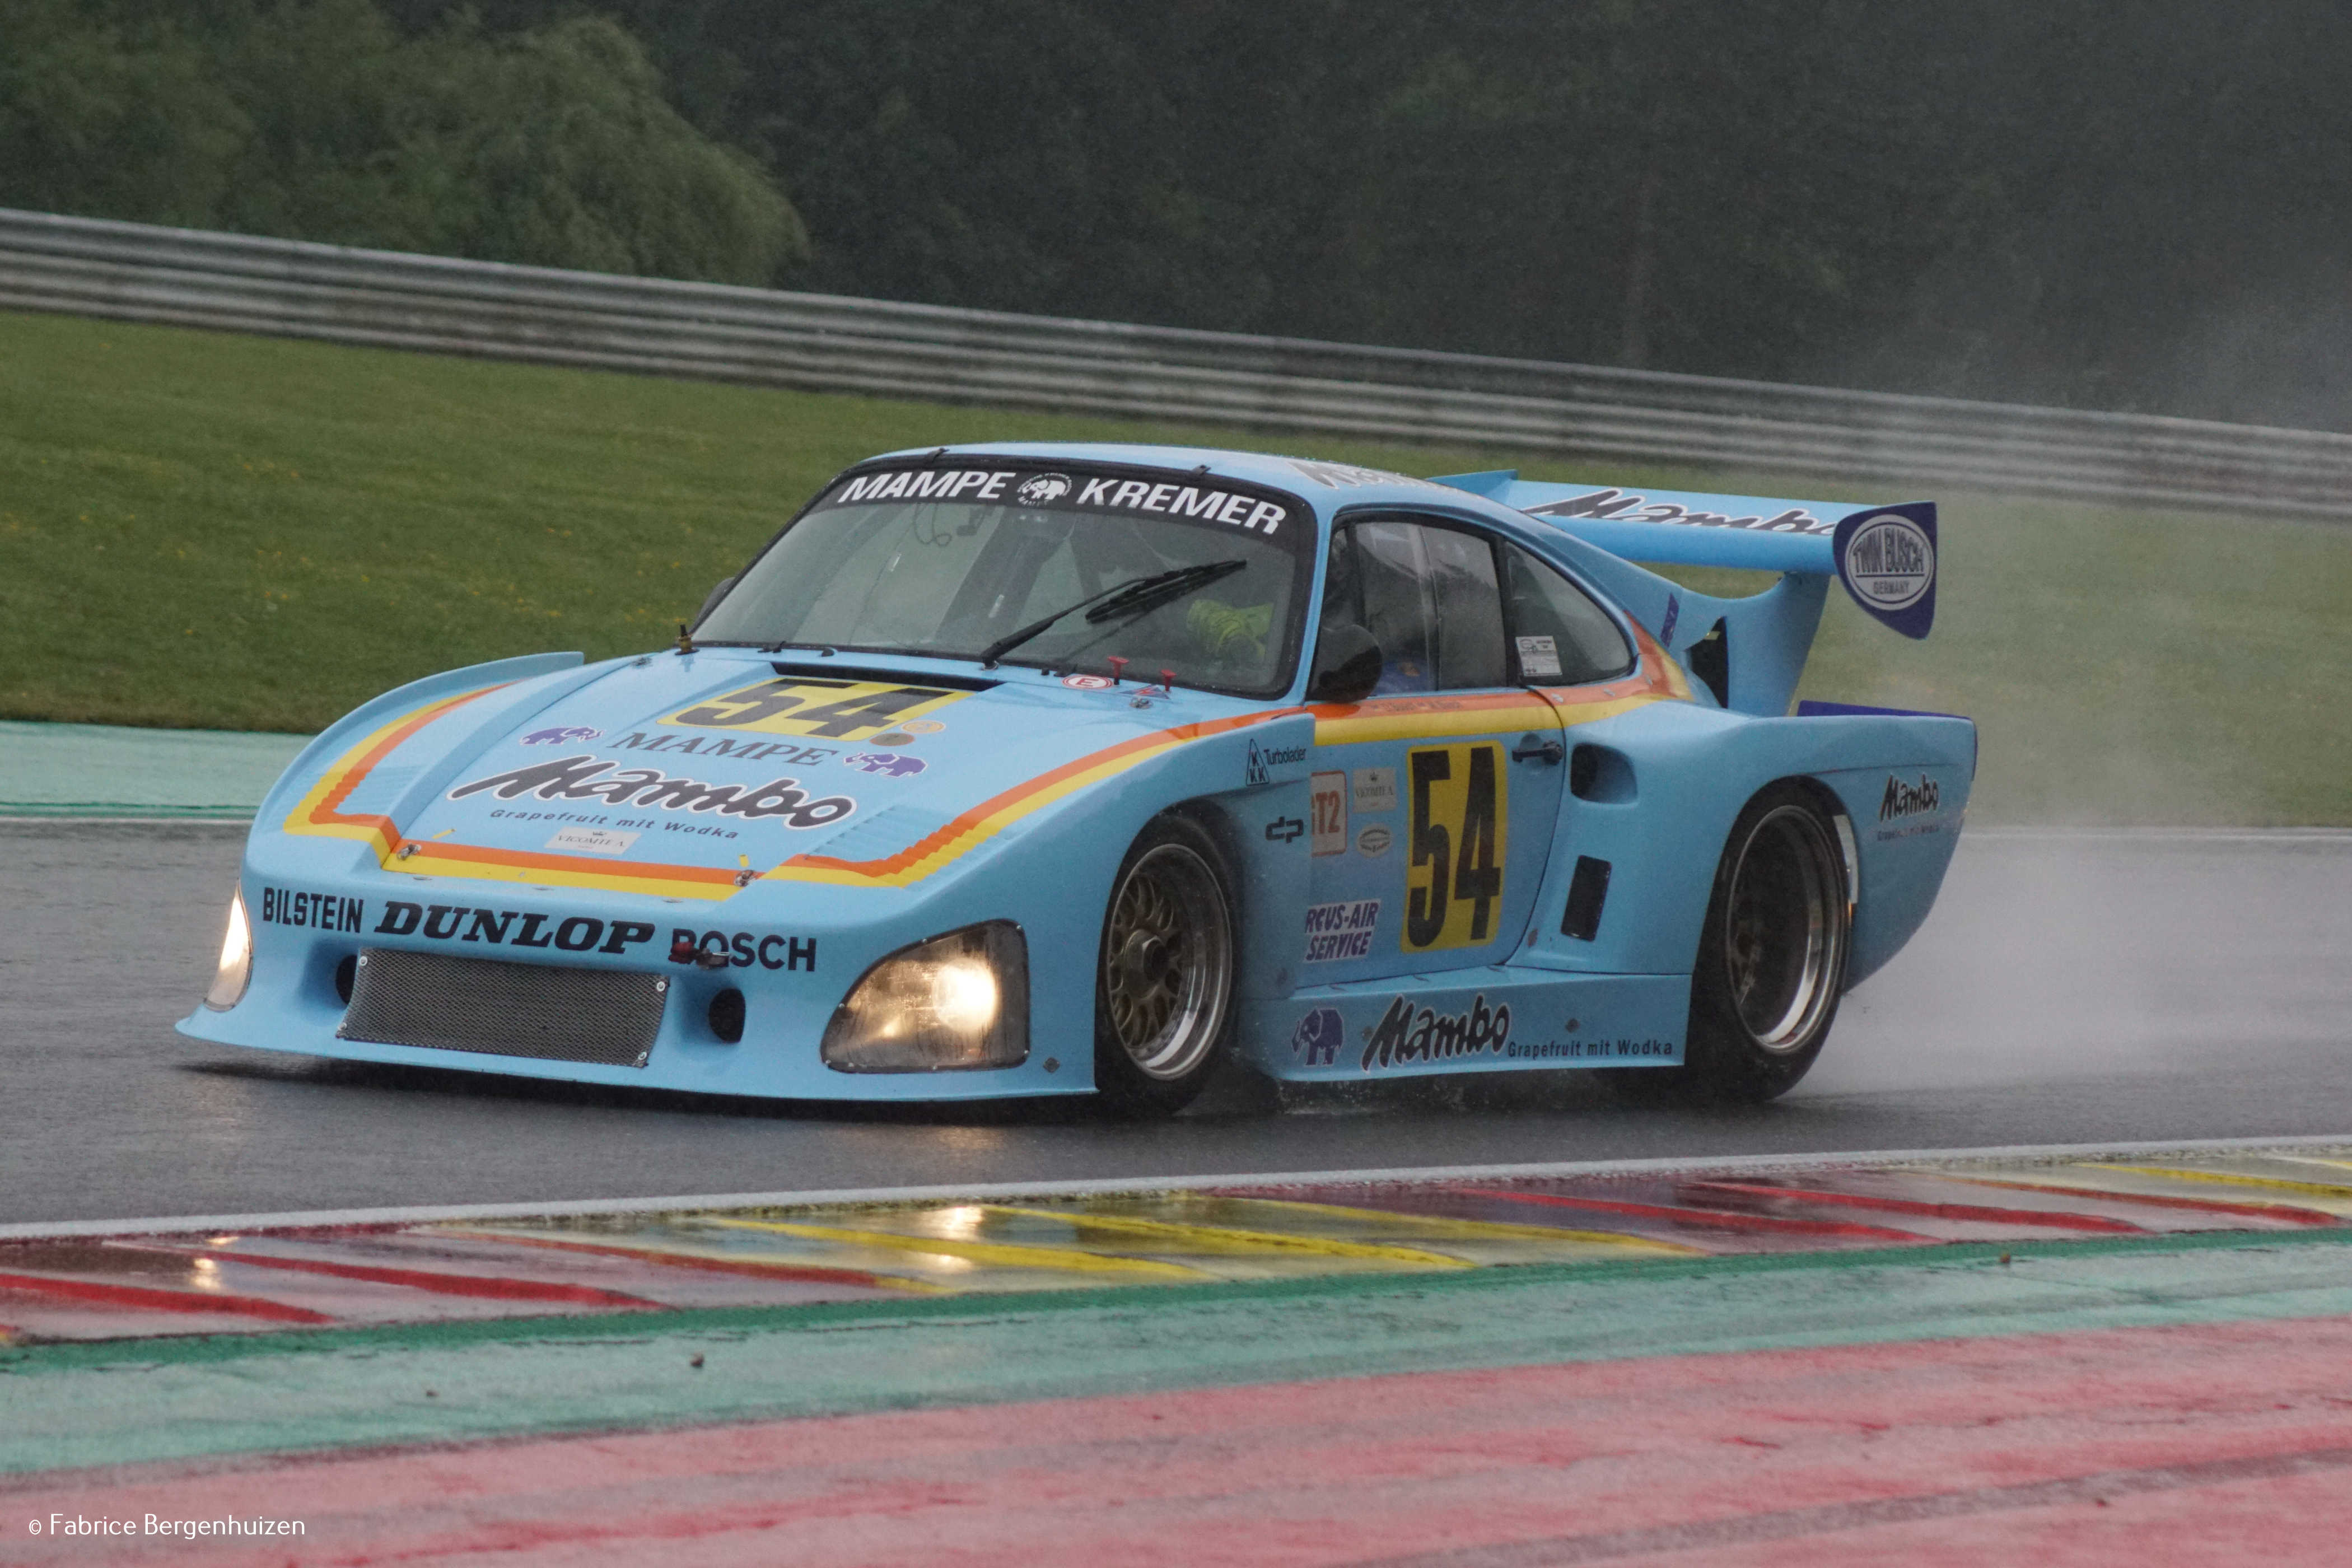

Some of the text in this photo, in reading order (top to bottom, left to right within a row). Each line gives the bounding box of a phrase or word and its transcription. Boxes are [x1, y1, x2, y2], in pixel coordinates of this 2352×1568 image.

[837, 471, 1016, 503] MAMPE
[1076, 478, 1286, 535] KREMER
[1873, 580, 1910, 594] GERMANY
[1075, 678, 1099, 687] E
[675, 678, 955, 738] 54
[606, 732, 840, 766] MAMPE
[1263, 746, 1306, 766] Turbolader
[449, 755, 856, 829] Mambo
[1880, 773, 1939, 822] Mambo
[490, 809, 739, 839] Grapefruit mit Wodka
[1408, 746, 1501, 947] 54
[263, 886, 364, 934] BILSTEIN
[374, 900, 656, 954] DUNLOP
[1305, 930, 1372, 961] SERVICE
[1361, 994, 1510, 1072] Mambo
[1508, 1039, 1673, 1060] Grapefruit mit Wodka
